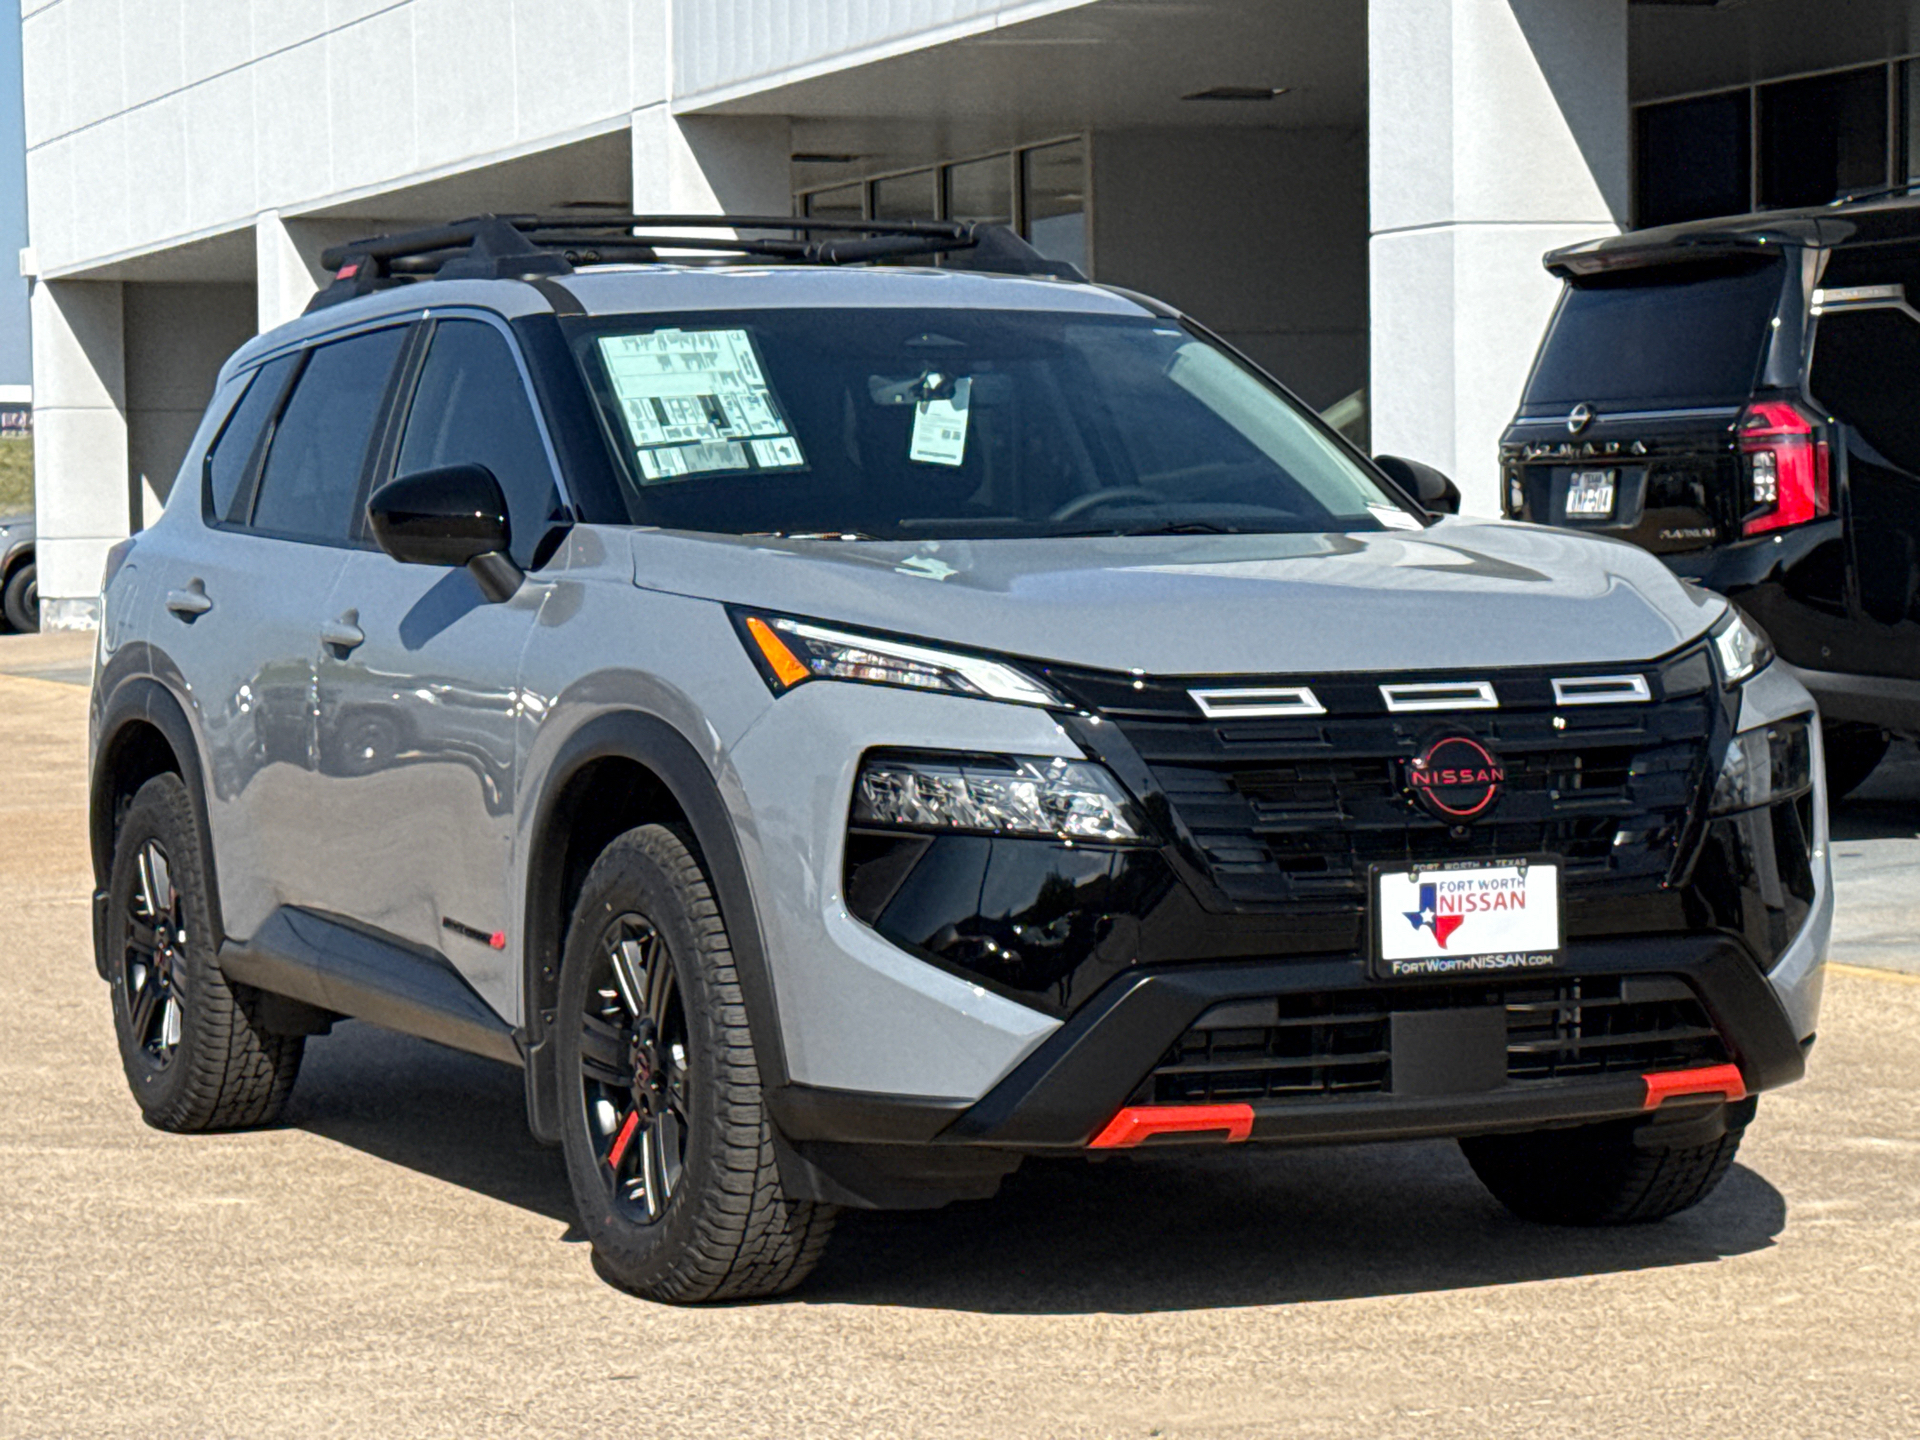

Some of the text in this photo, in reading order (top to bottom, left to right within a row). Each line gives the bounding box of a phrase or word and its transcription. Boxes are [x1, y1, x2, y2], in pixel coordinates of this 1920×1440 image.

[1412, 768, 1504, 785] NISSAN
[1413, 858, 1527, 872] FORT WORTH TEXAS
[1439, 878, 1526, 893] FORT WORTH
[1439, 890, 1526, 913] NISSAN
